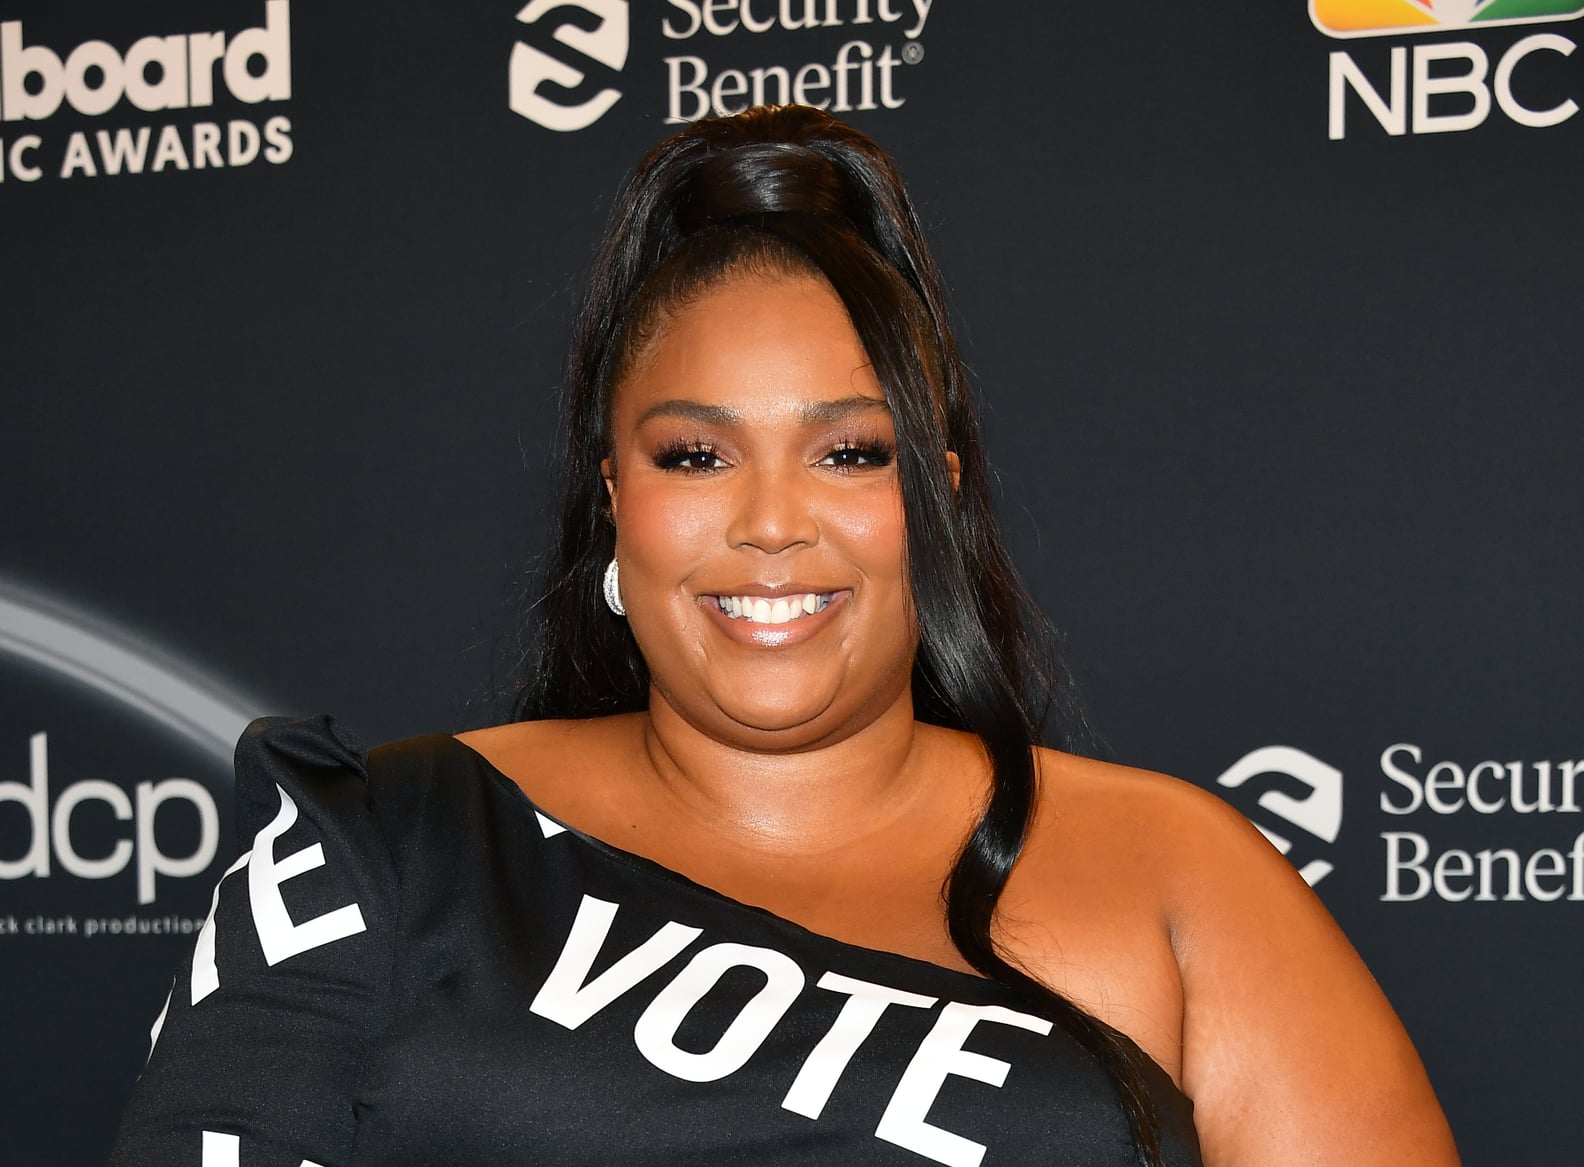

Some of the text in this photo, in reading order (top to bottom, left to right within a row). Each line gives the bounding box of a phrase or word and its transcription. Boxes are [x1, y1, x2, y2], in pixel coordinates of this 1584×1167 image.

[1328, 33, 1580, 140] NBC
[60, 116, 293, 178] AWARDS
[1379, 743, 1584, 815] Secur
[0, 731, 219, 905] dcp
[24, 914, 77, 935] clark
